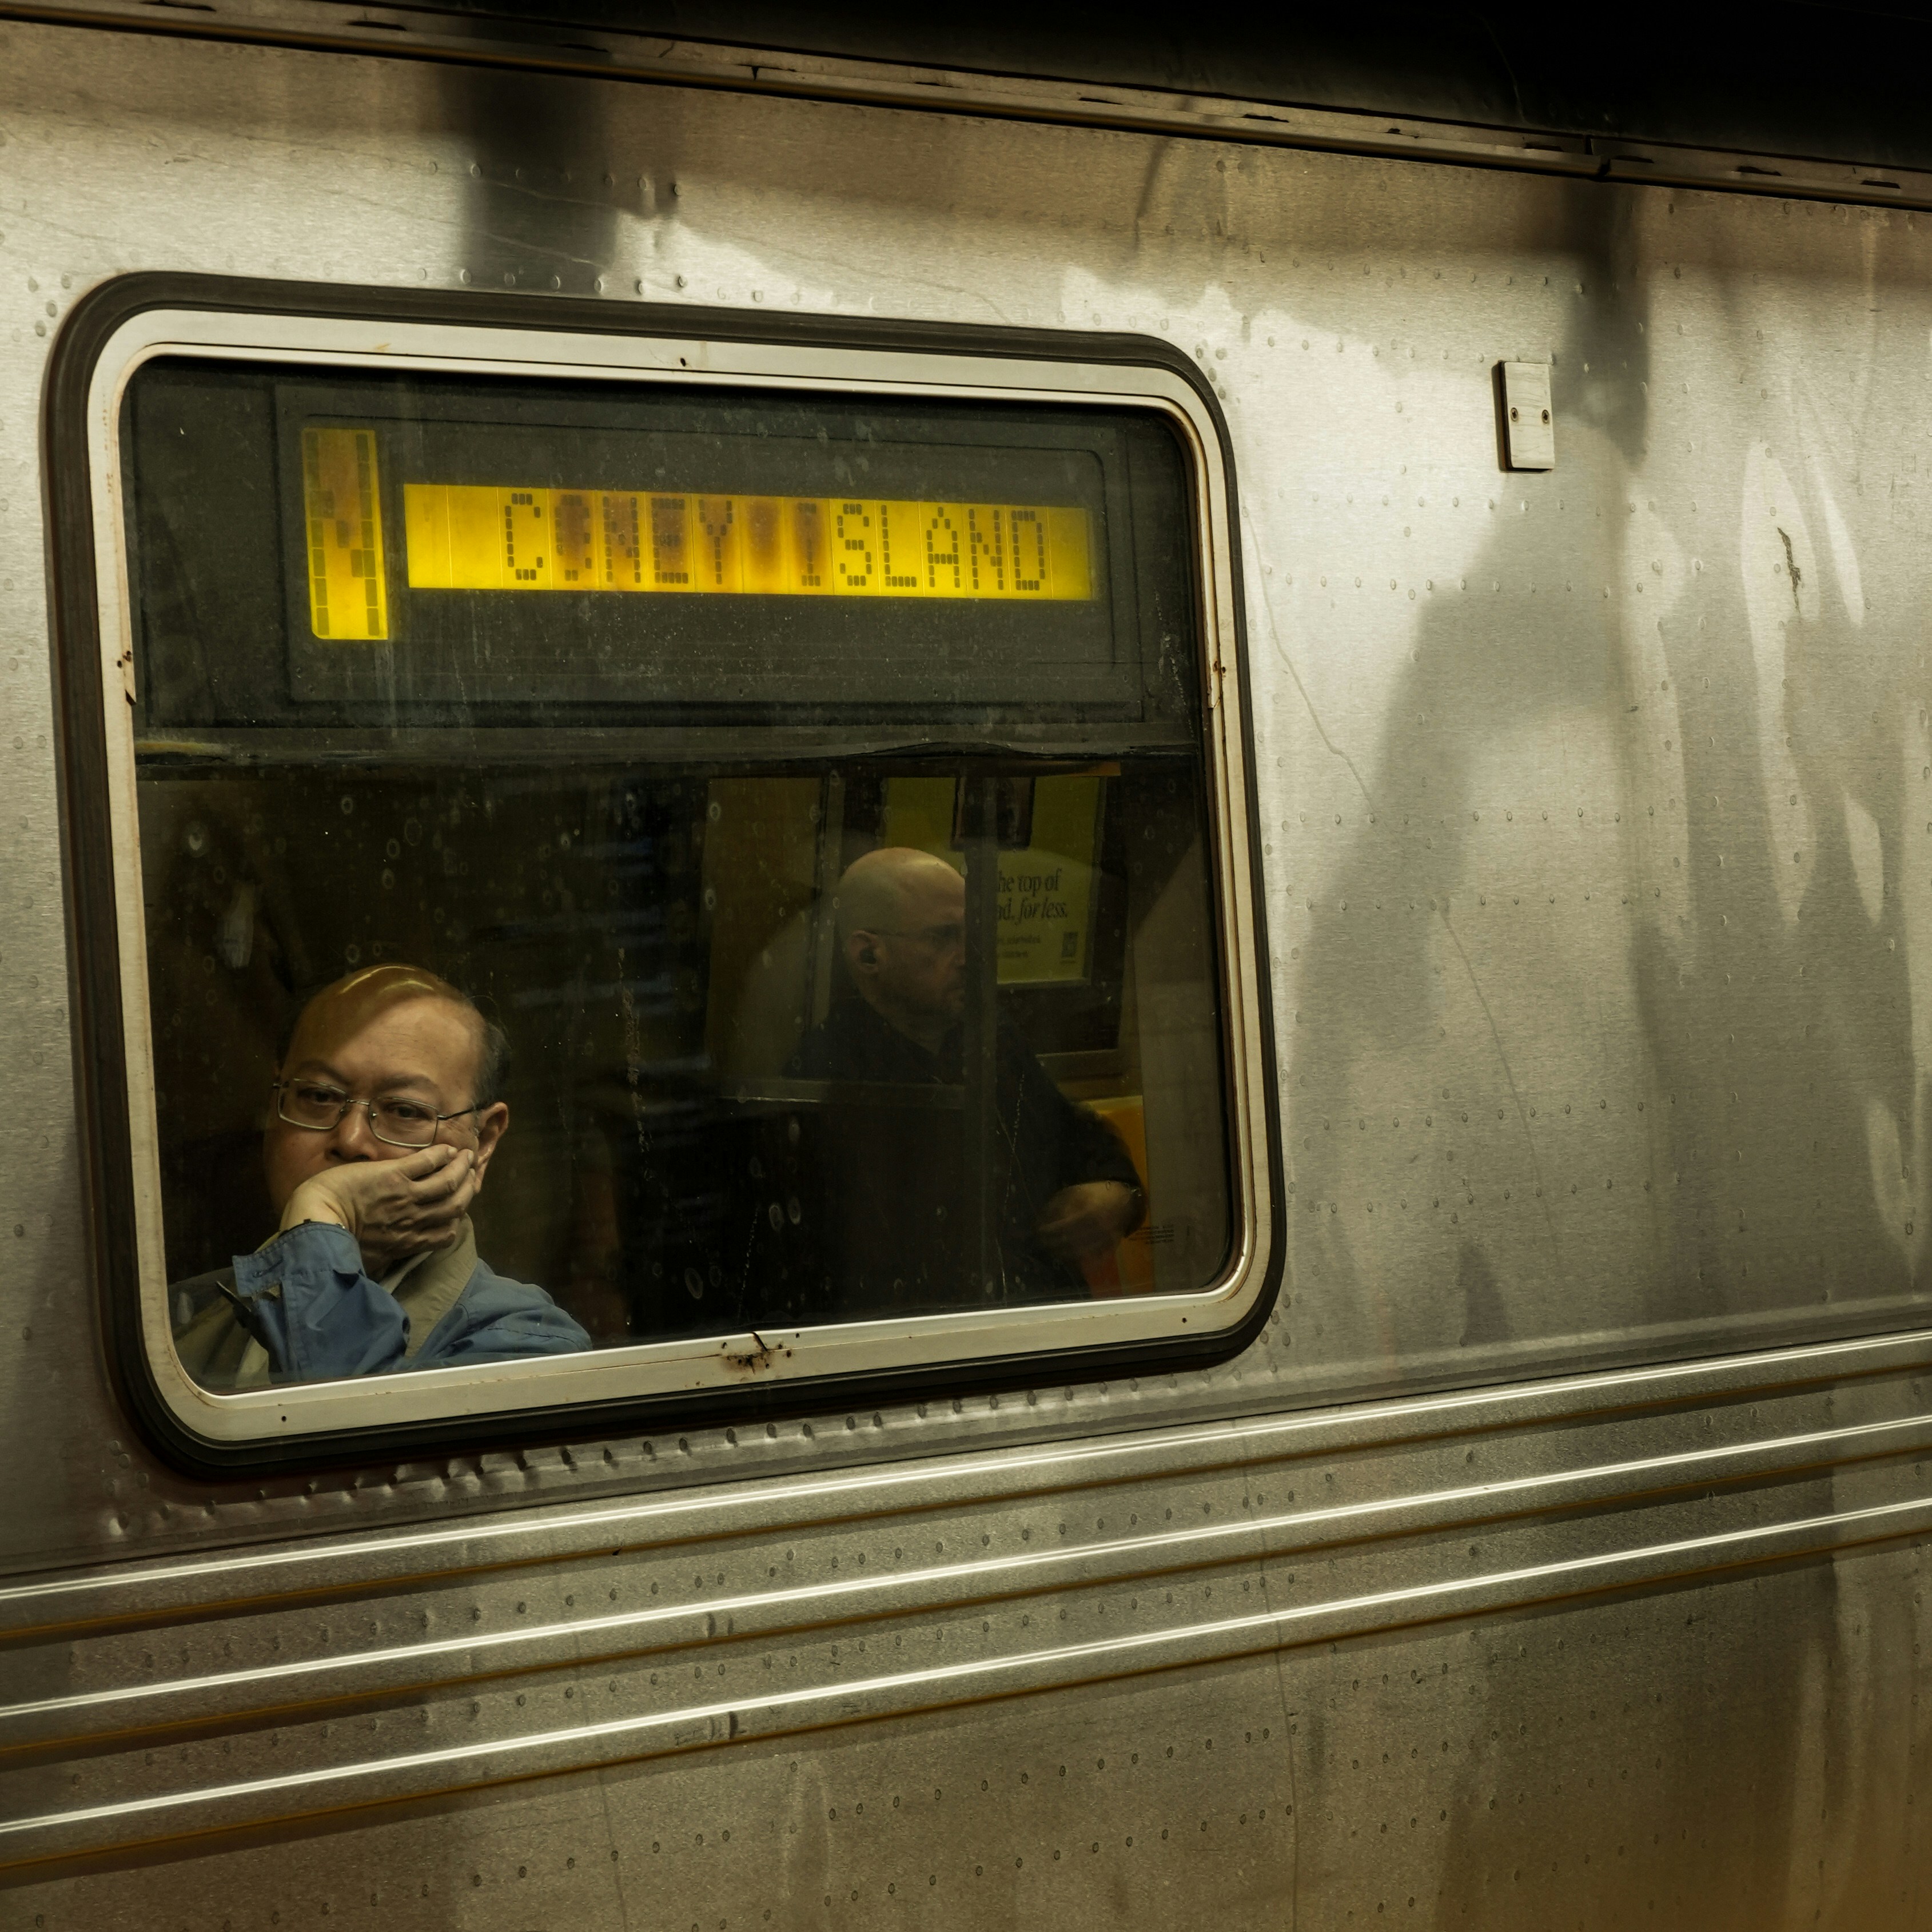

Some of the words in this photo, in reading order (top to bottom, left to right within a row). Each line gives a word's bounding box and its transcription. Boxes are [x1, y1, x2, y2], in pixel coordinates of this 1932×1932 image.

[504, 492, 734, 585] CONEY
[796, 502, 1046, 591] ISLAND
[998, 870, 1015, 893] he
[1018, 876, 1041, 897] top
[1045, 868, 1062, 891] of
[1015, 897, 1040, 926] for
